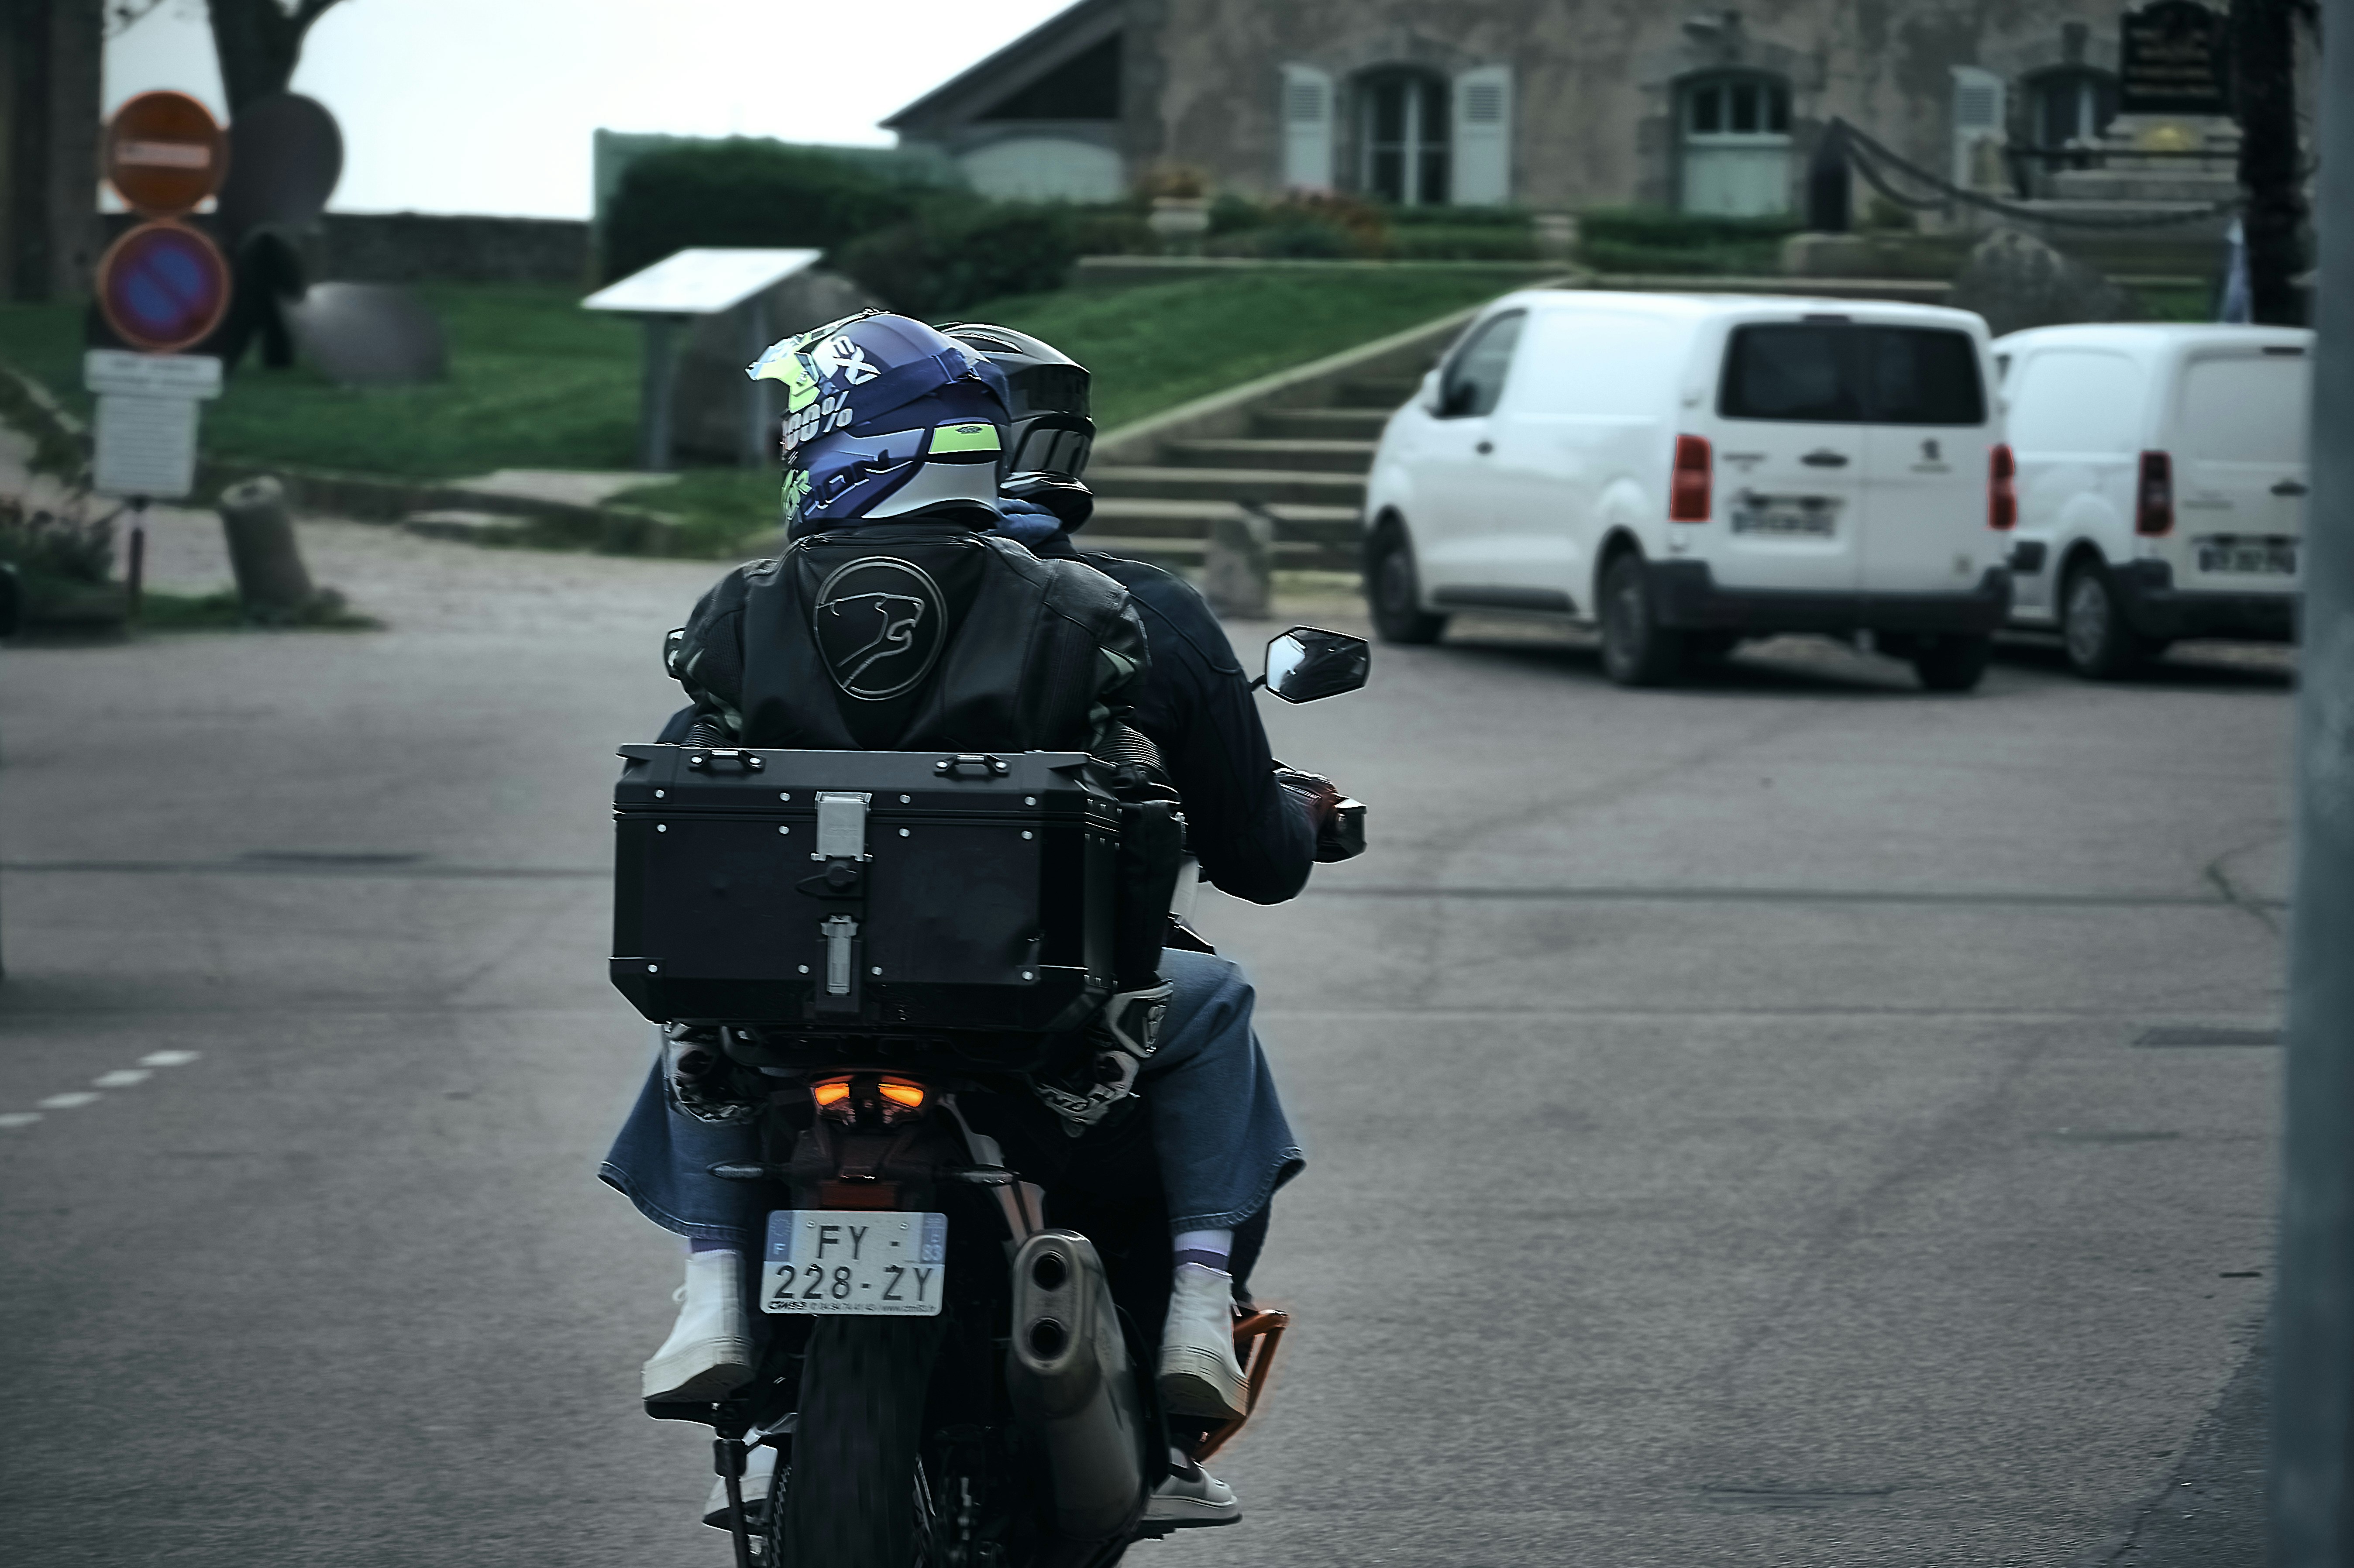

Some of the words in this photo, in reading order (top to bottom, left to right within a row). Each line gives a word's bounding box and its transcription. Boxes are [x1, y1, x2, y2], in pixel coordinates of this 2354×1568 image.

[774, 1243, 786, 1255] F
[817, 1225, 869, 1260] FY
[774, 1264, 934, 1301] 228-ZY
